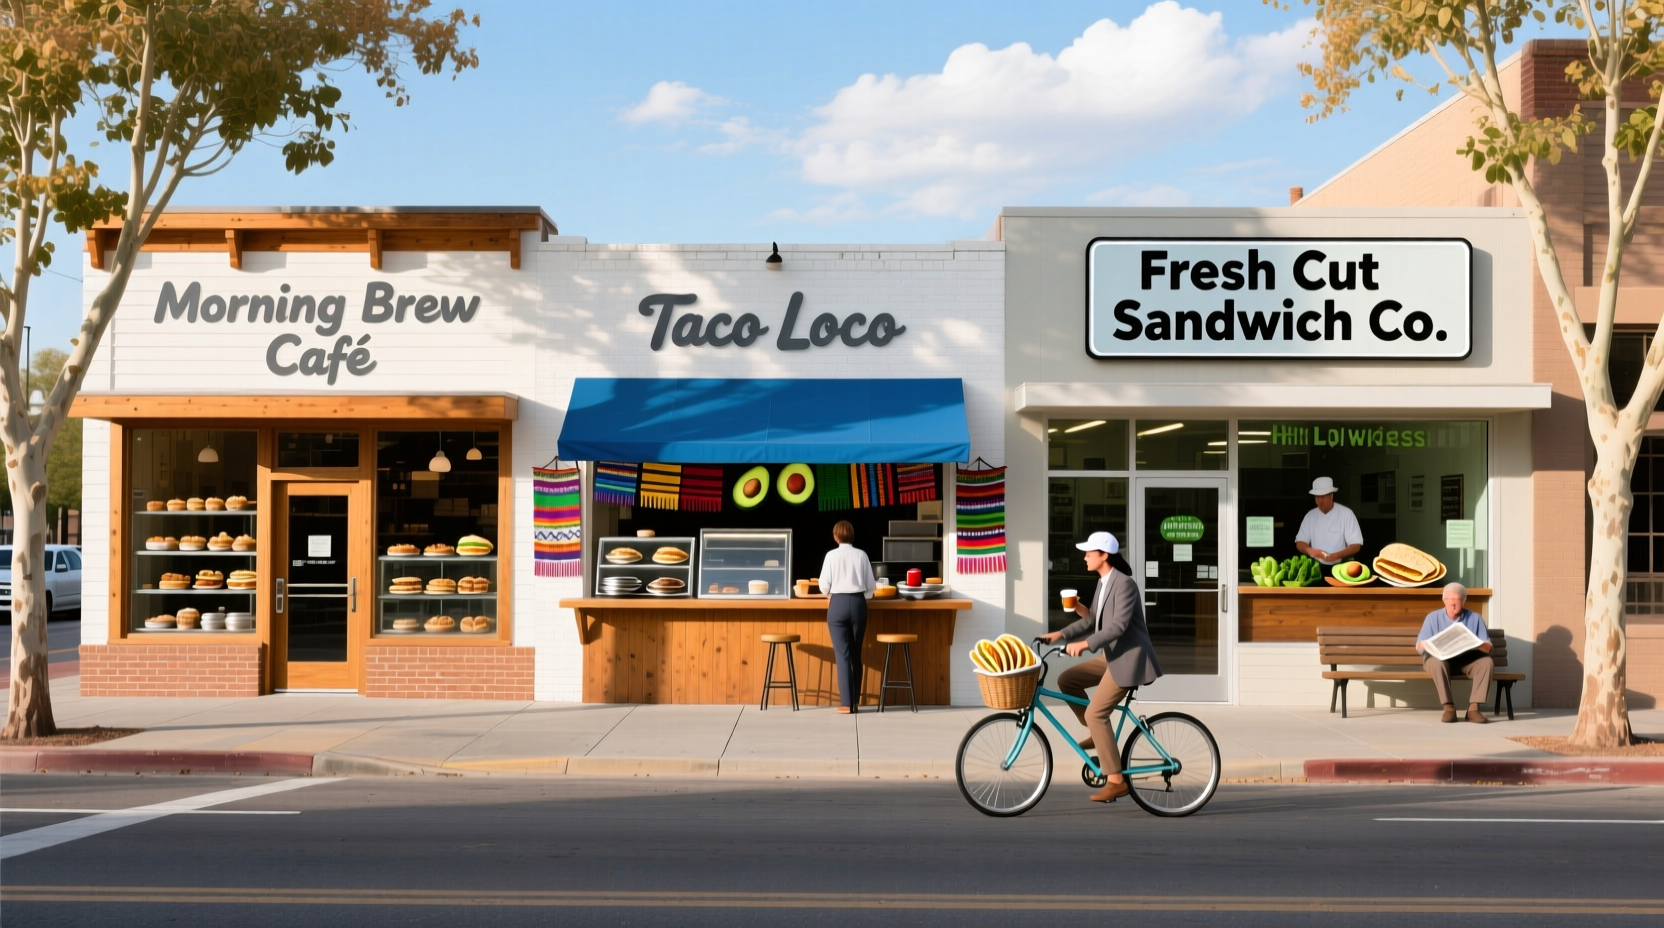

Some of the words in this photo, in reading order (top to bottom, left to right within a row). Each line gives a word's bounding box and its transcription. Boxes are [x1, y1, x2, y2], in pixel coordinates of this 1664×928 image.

[1141, 249, 1276, 291] Fresh
[1293, 250, 1380, 291] Cut
[154, 281, 346, 337] Morning
[361, 281, 481, 323] Brew
[638, 293, 769, 352] Taco
[776, 291, 907, 352] Loco
[1113, 298, 1352, 342] Sandwich
[1369, 299, 1448, 342] Co.
[266, 333, 377, 386] Café
